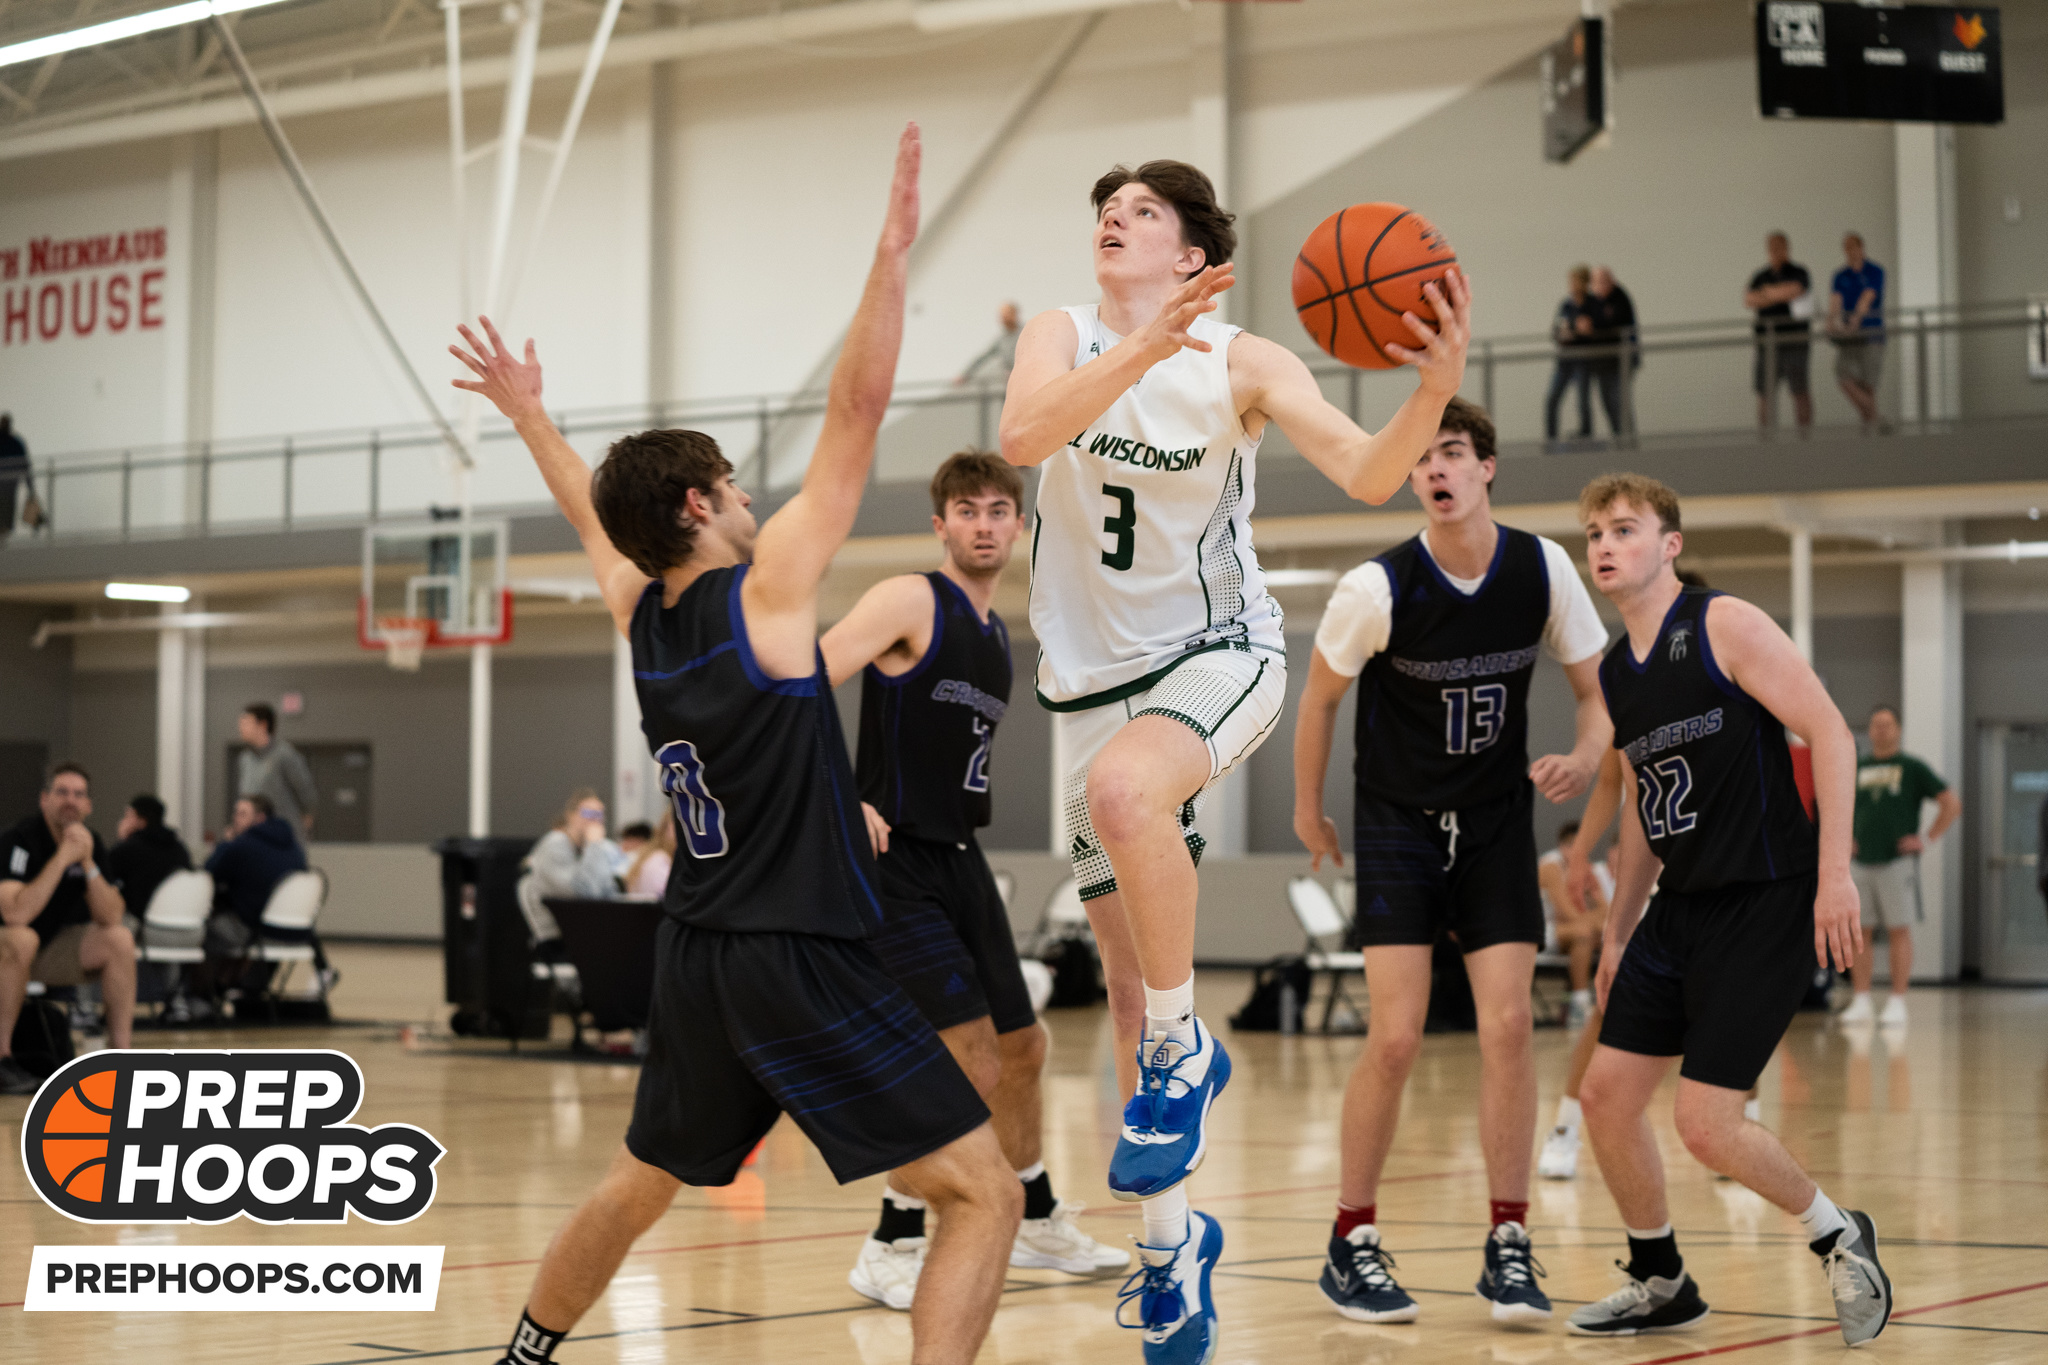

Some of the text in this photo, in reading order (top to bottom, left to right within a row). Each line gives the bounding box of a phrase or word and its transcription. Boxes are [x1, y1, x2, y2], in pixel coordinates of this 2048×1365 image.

[4, 269, 165, 345] HOUSE
[1089, 432, 1207, 472] WISCONSIN
[1101, 482, 1137, 572] 3
[1441, 683, 1507, 754] 13
[654, 740, 729, 859] 0
[1639, 755, 1698, 840] 22
